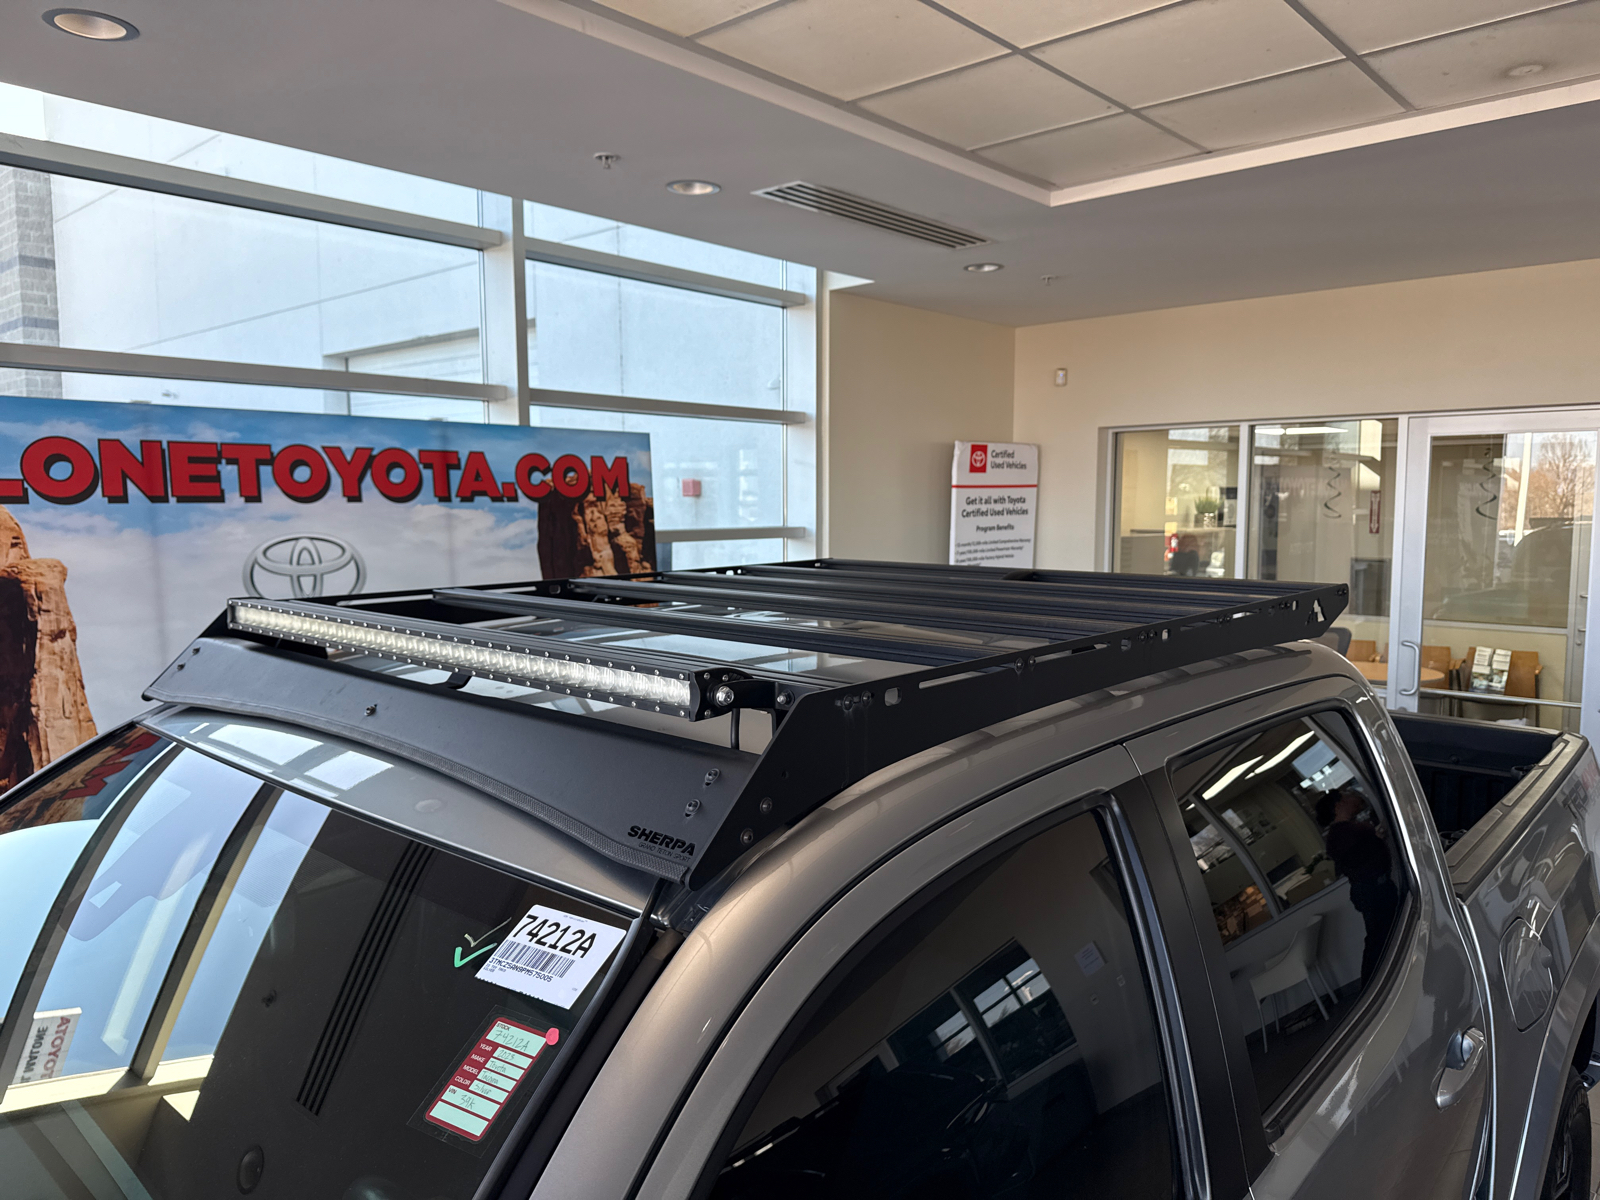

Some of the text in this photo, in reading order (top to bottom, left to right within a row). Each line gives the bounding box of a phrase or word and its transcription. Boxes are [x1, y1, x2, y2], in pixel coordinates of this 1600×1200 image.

[990, 449, 1015, 459] Certified
[0, 435, 632, 504] ONETOYOTA.COM
[990, 460, 1027, 470] Used Vehicles
[965, 496, 978, 506] Get
[984, 495, 992, 505] all
[993, 494, 1006, 504] with
[1007, 495, 1026, 506] Toyota
[961, 506, 1029, 518] Certified Used Vehicles
[976, 523, 1015, 533] Program Benefits
[627, 825, 696, 856] SHERPA
[638, 841, 657, 851] GRAND
[512, 914, 597, 959] 74212A
[496, 1022, 511, 1032] STOCK
[493, 1029, 531, 1052] 74212A
[479, 1042, 493, 1052] YEAR
[470, 1053, 486, 1063] MAKE
[497, 1049, 515, 1061] 2023
[462, 1064, 479, 1075] MODEL
[454, 1075, 471, 1086] COLOR
[448, 1087, 458, 1095] VIN
